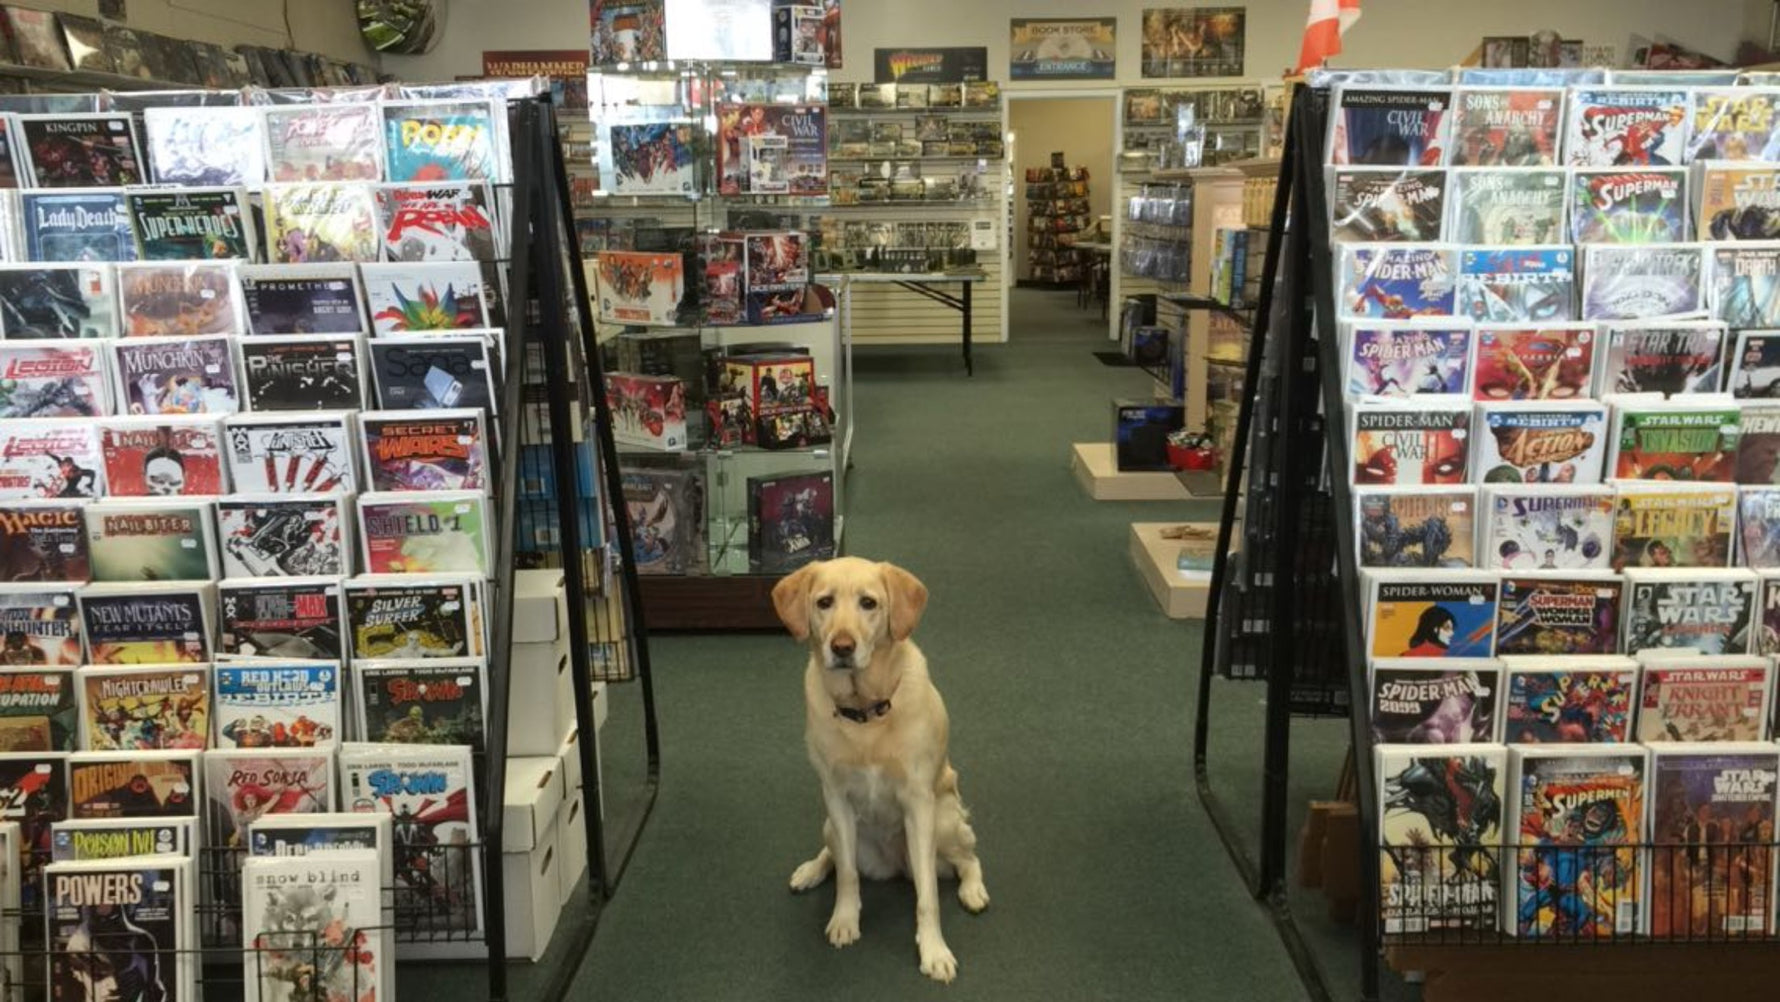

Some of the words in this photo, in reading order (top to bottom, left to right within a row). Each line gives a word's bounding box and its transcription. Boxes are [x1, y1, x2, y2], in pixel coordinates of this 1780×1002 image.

[1031, 25, 1061, 35] BOOK
[1062, 24, 1098, 35] STORE
[487, 61, 585, 76] WARHAMMER
[1346, 95, 1387, 103] AMAZING
[1466, 94, 1501, 110] SONS
[781, 114, 813, 127] CIVIL
[1387, 110, 1425, 124] CIVIL
[1485, 110, 1546, 126] ANARCHY
[1592, 111, 1671, 137] SUPERMAN
[45, 121, 98, 133] KINGPIN
[793, 125, 818, 137] WAR
[1398, 122, 1429, 137] WAR
[1470, 175, 1505, 190] SONS
[1490, 190, 1552, 205] ANARCHY
[1599, 179, 1679, 210] SUPERMAN
[38, 206, 76, 231] Lady
[76, 205, 119, 230] Death
[124, 349, 204, 376] MUNCHKIN
[1361, 414, 1453, 428] SPIDER-MAN
[1640, 415, 1682, 426] STAR
[1682, 414, 1724, 425] WARS
[381, 425, 459, 435] SECRET
[377, 435, 469, 461] WARS
[1507, 428, 1586, 466] ACTION
[1512, 495, 1600, 517] SUPERMAN
[1633, 509, 1717, 538] LEGACY
[1382, 585, 1483, 598] SPIDER-WOMAN
[1656, 585, 1746, 606] STAR
[371, 595, 423, 615] SILVER
[1529, 594, 1594, 607] SUPERMAN
[89, 605, 122, 625] NEW
[123, 603, 193, 624] MUTANTS
[365, 611, 421, 628] SURFER
[1540, 615, 1590, 624] WOMAN
[1657, 606, 1745, 624] WARS
[93, 624, 130, 632] FEAR
[240, 668, 271, 687] RED
[1663, 671, 1706, 682] STAR
[1706, 670, 1750, 681] WARS
[101, 677, 190, 699] NIGHTCRAWLER
[1378, 675, 1482, 701] SPIDER-MAN
[1669, 685, 1742, 701] KNIGHT
[1379, 700, 1422, 714] 2099
[227, 770, 257, 787] RED
[258, 769, 309, 787] SONJA
[73, 830, 129, 859] POISON
[255, 873, 299, 884] snow
[307, 870, 361, 884] blind
[56, 873, 143, 906] POWERS
